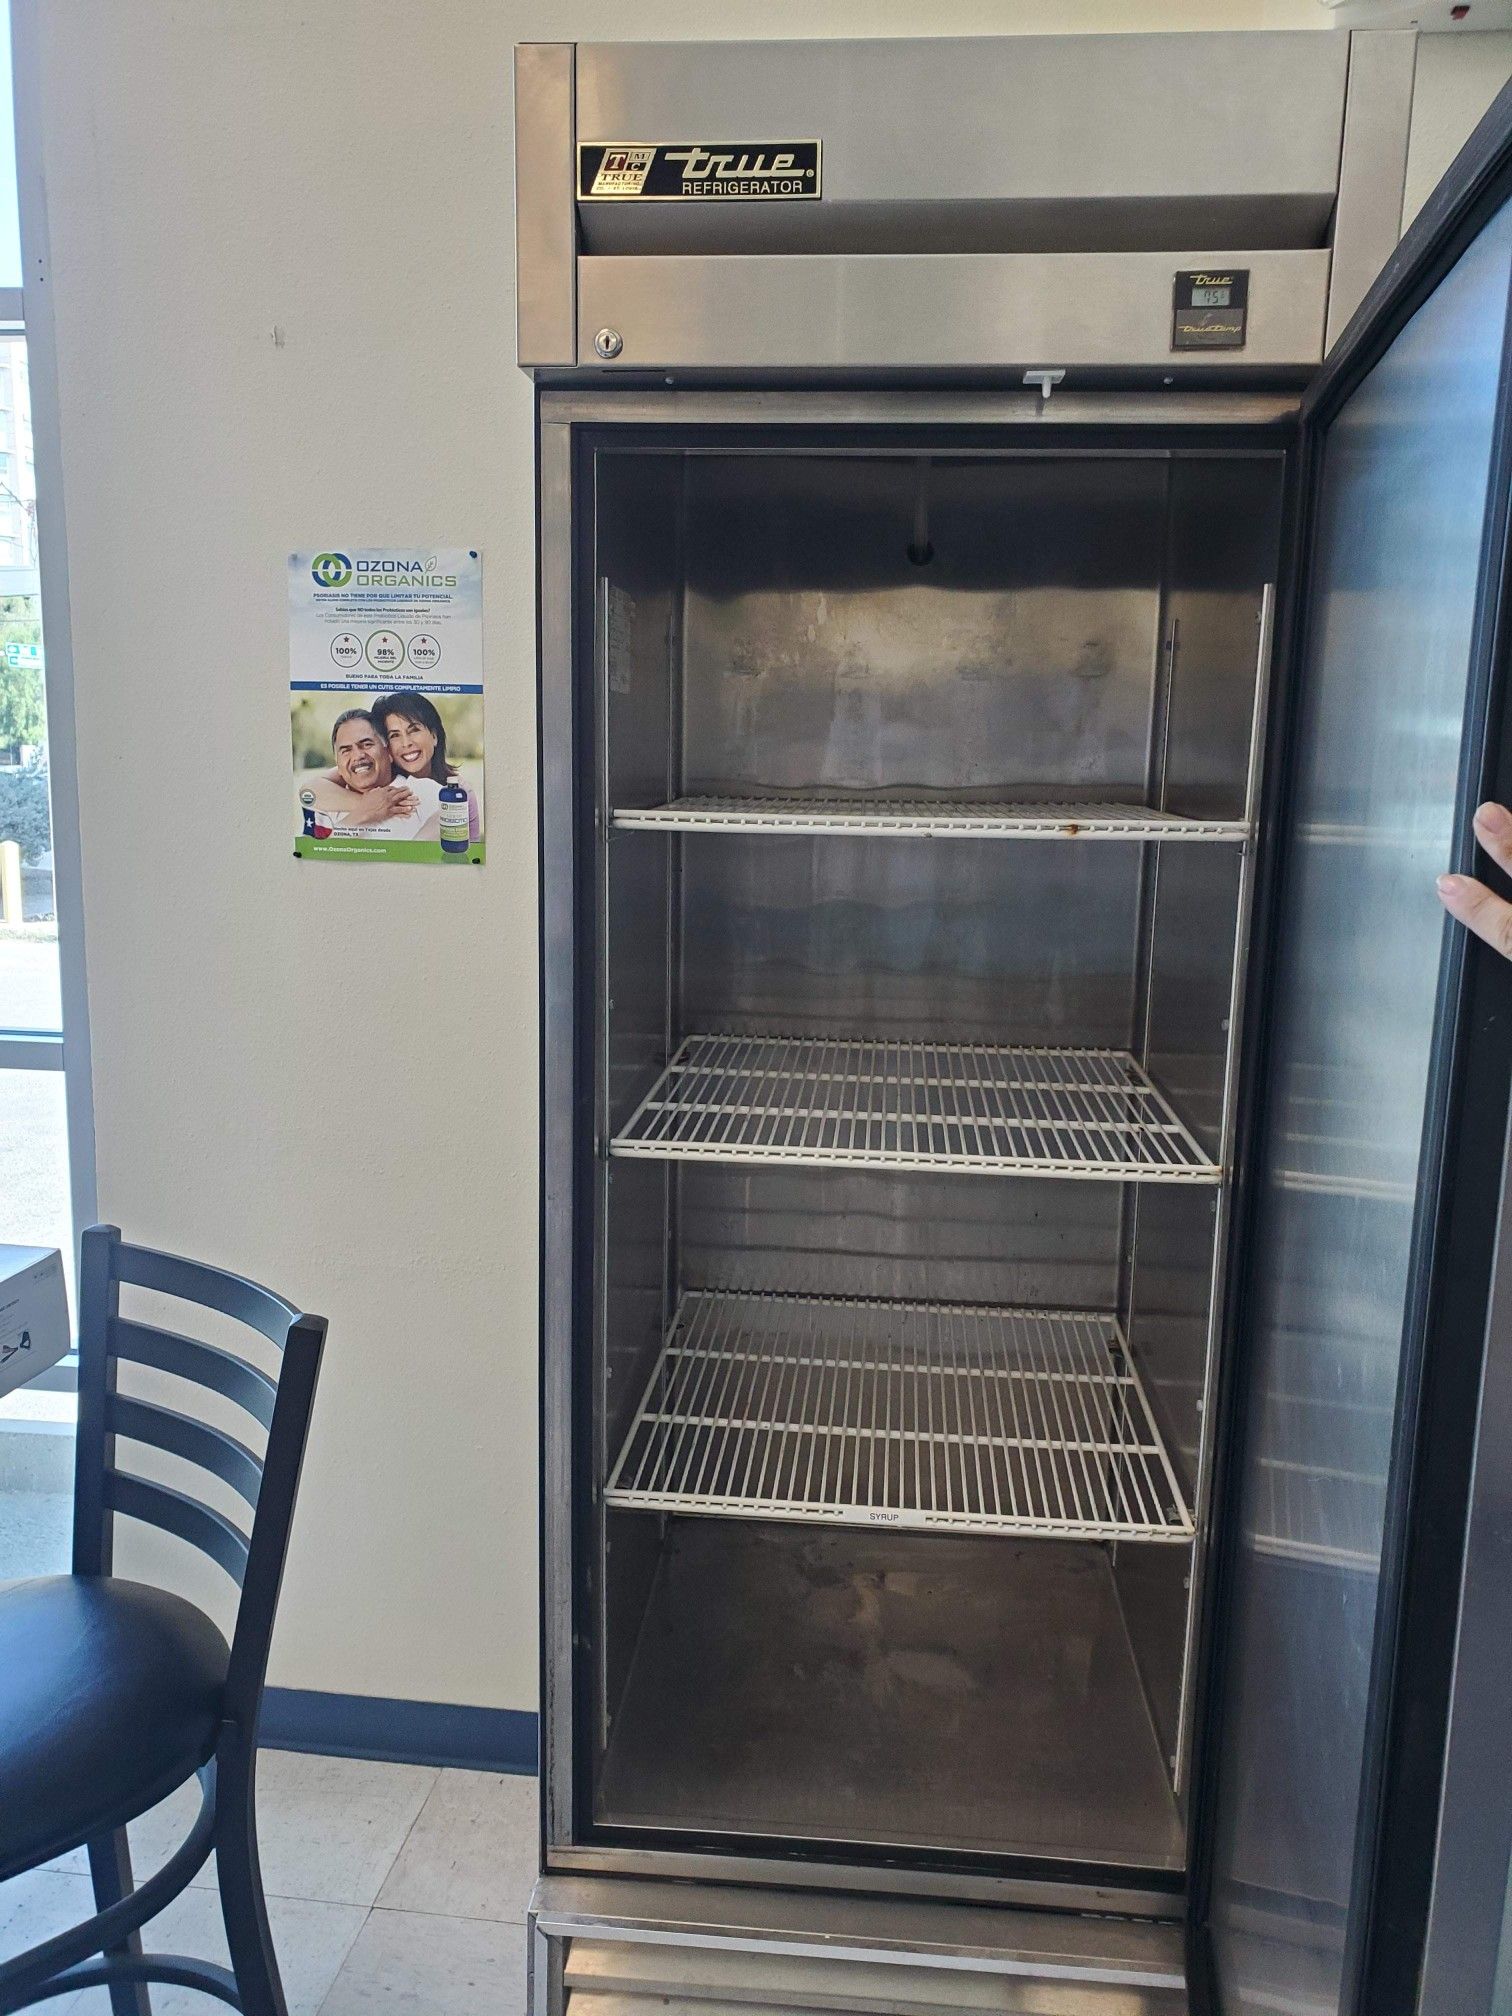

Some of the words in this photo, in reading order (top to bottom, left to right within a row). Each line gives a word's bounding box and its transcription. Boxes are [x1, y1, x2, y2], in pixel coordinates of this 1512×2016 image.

[601, 173, 643, 181] TRUE
[682, 180, 803, 195] REFRIGERATOR
[356, 560, 423, 572] OZONA
[356, 574, 457, 587] ORGANICS
[313, 845, 387, 854] www.OzonaOrganics.com
[870, 1512, 899, 1522] SYRUP
